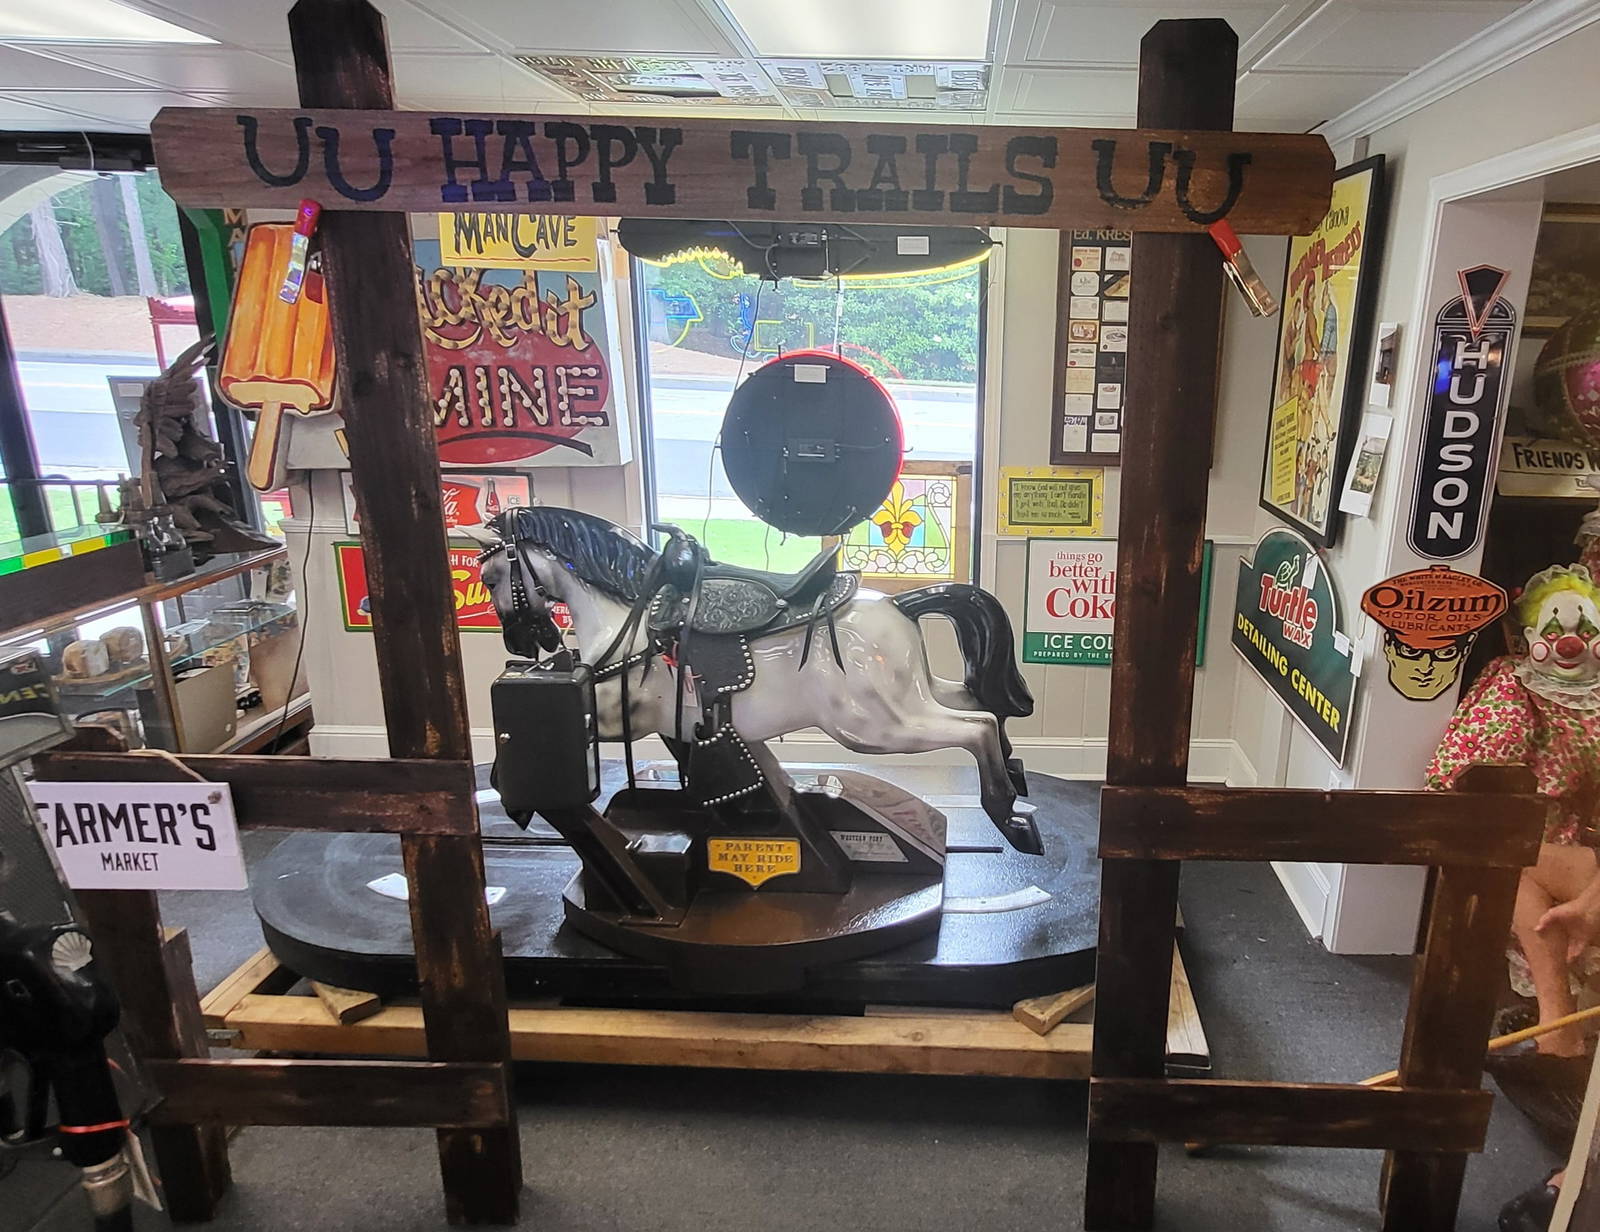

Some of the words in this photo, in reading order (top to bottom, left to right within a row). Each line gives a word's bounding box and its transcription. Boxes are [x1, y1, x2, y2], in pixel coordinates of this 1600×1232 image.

[429, 118, 684, 206] HAPPY
[730, 131, 1059, 216] TRAILS
[1096, 230, 1131, 241] KRES
[1426, 340, 1490, 540] HUDSON
[1512, 442, 1585, 470] FRIENDS
[1057, 551, 1086, 562] things
[1087, 552, 1103, 565] go
[1049, 560, 1102, 579] better
[1259, 574, 1318, 630] Turtle
[1370, 586, 1503, 617] Oilzum
[1377, 610, 1441, 622] MOTOR
[1446, 613, 1482, 622] OILS
[1283, 623, 1313, 649] WAX
[1391, 621, 1472, 632] LUBRICANTS
[1044, 634, 1073, 649] ICE
[1080, 635, 1113, 650] COL
[1237, 612, 1289, 677] DETAILING
[1290, 669, 1342, 734] CENTER
[725, 842, 785, 853] PARENT
[101, 852, 160, 872] MARKET
[718, 853, 750, 862] MAY
[757, 853, 794, 863] RIDE
[733, 864, 777, 873] HERE
